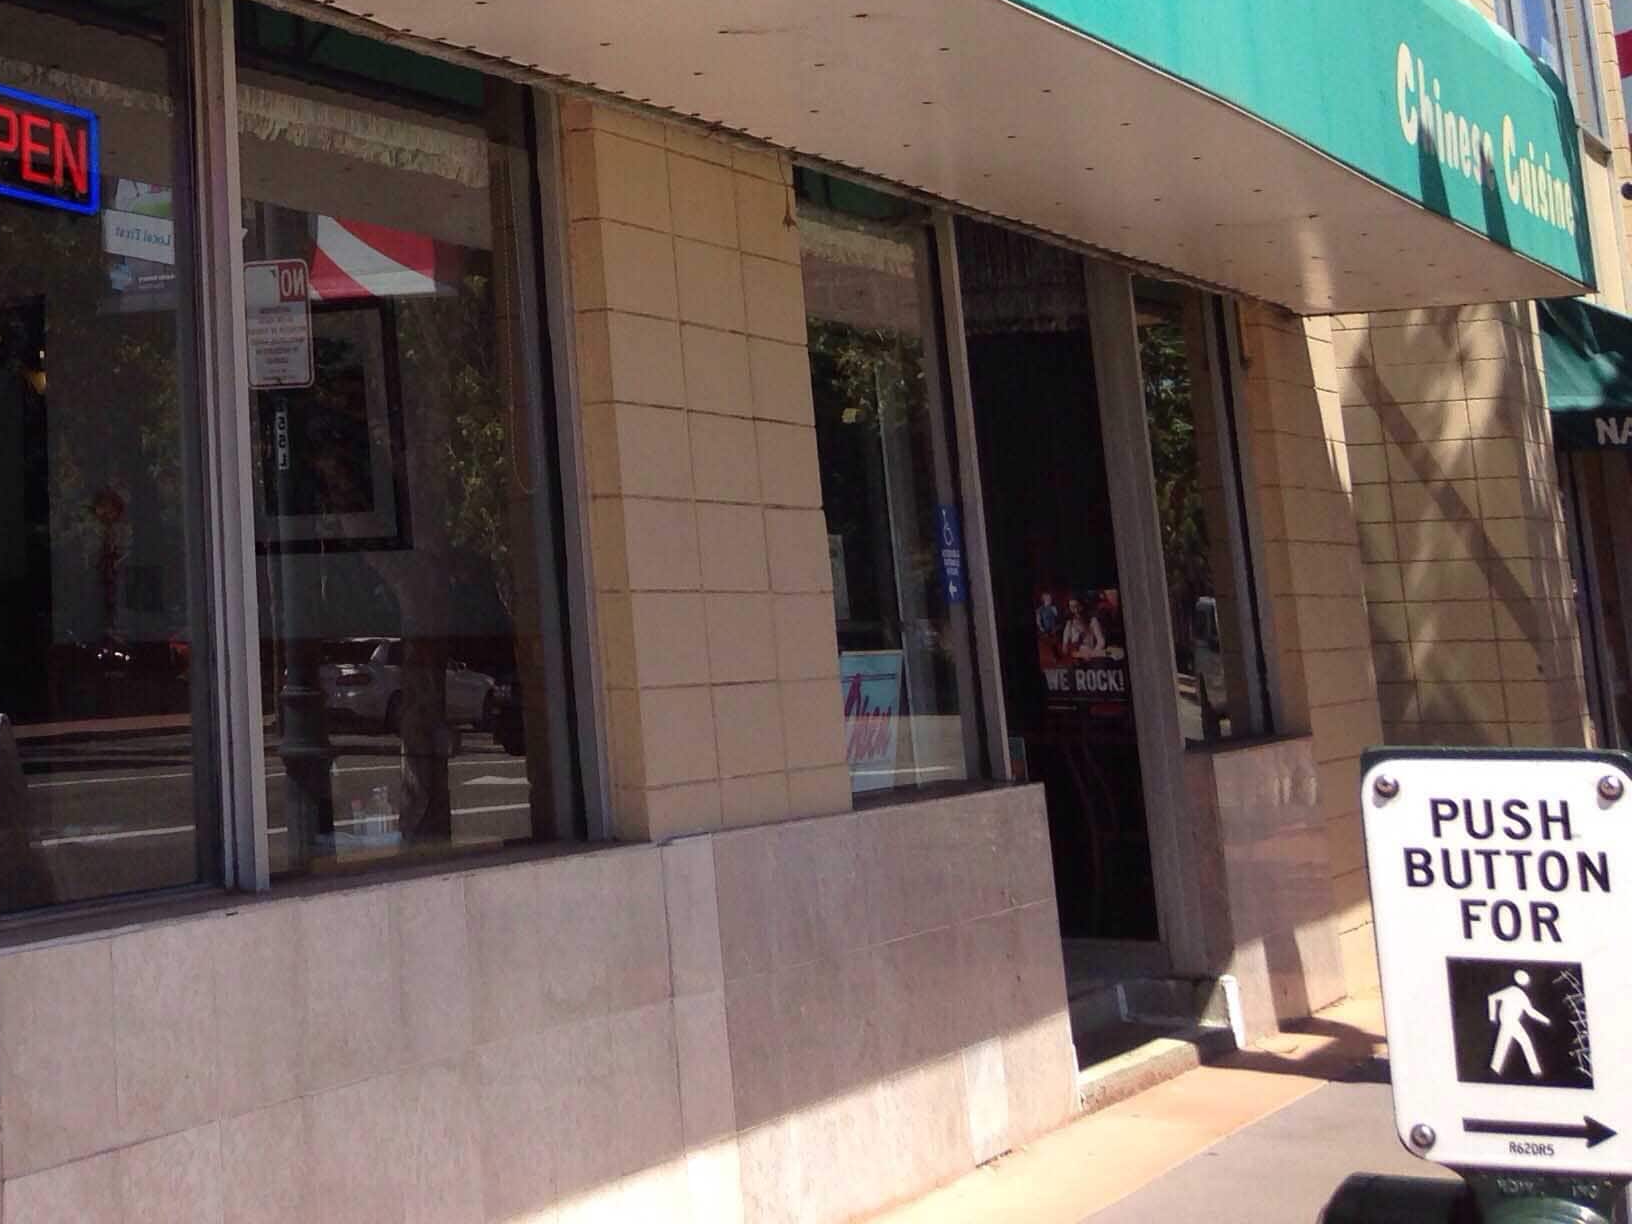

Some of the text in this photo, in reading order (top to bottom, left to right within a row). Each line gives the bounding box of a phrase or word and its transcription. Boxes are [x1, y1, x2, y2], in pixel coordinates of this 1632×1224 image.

[1396, 40, 1496, 192] Chinese
[1044, 668, 1125, 693] WE ROCK!
[1429, 798, 1574, 841] PUSH
[1403, 846, 1612, 894] BUTTON
[1459, 898, 1564, 943] FOR
